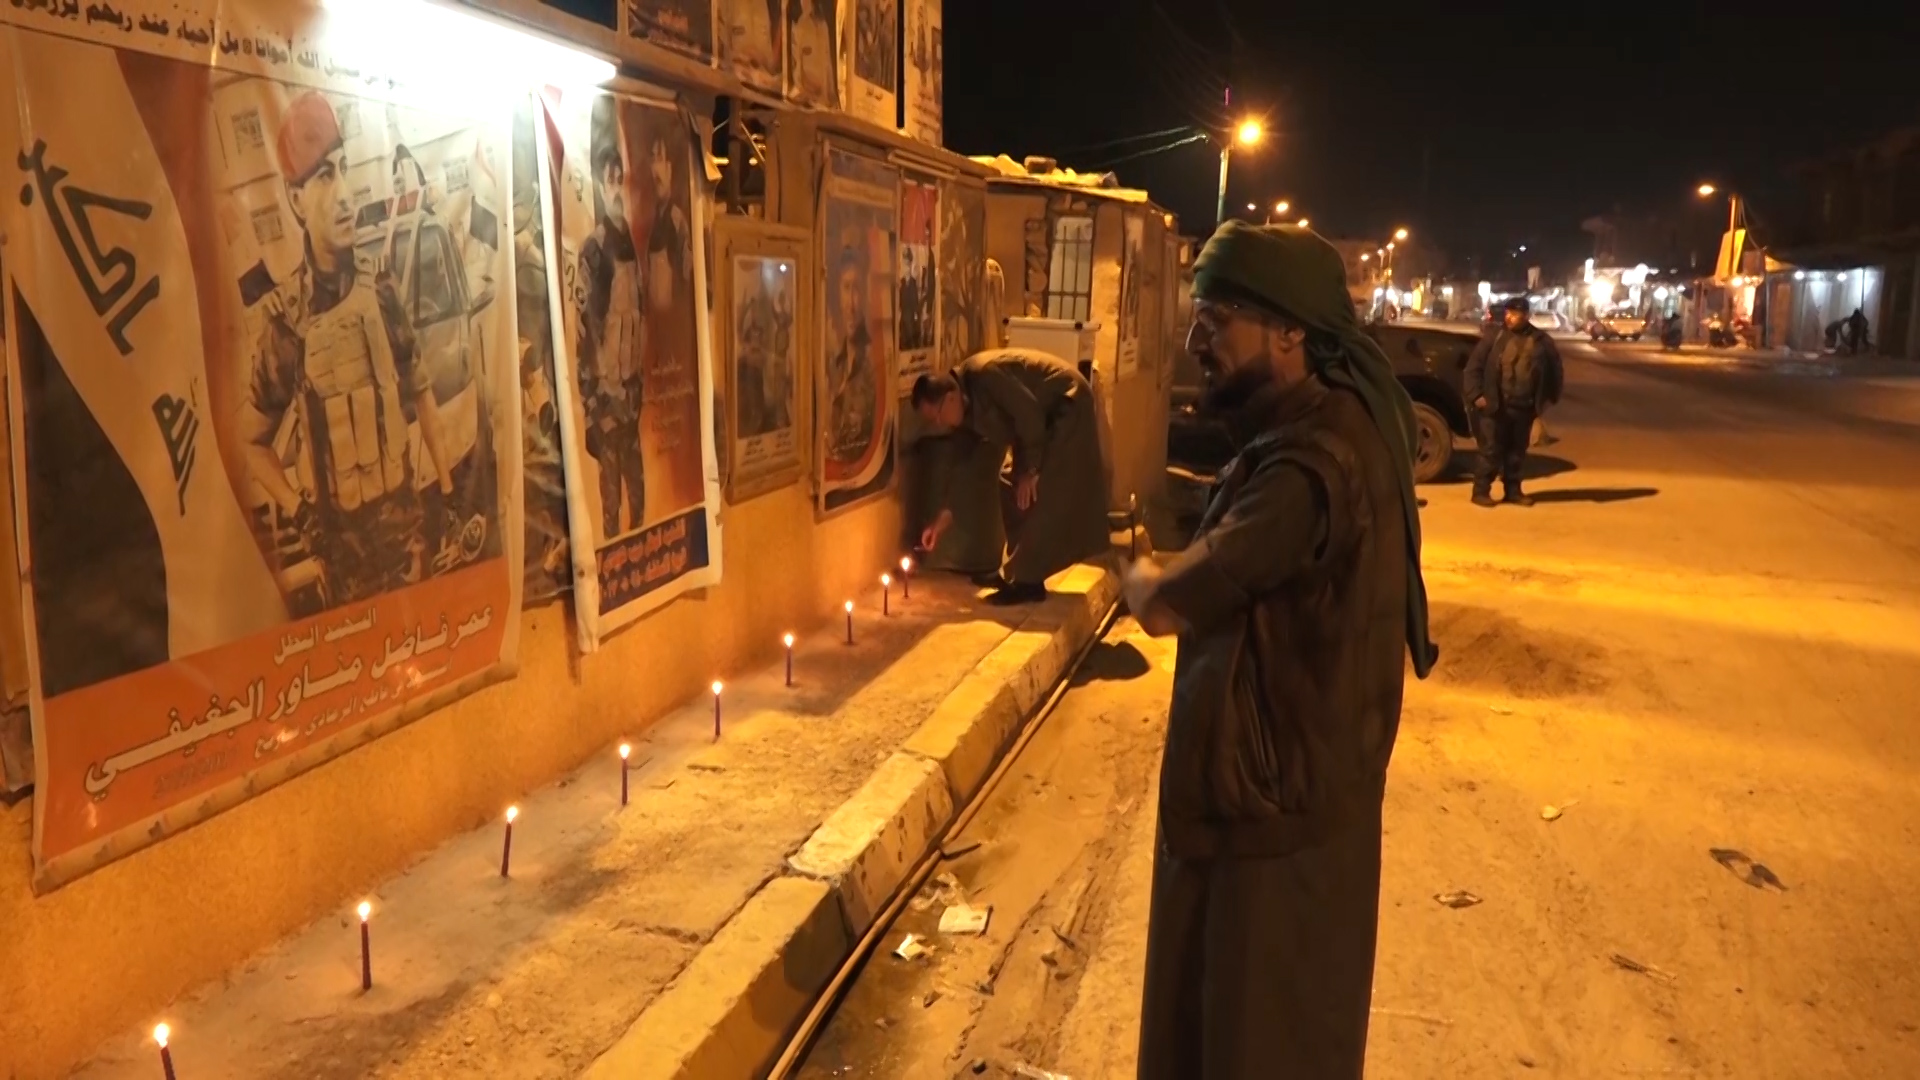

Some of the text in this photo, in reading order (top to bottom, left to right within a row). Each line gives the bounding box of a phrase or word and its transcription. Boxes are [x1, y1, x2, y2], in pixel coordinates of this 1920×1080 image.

[86, 3, 133, 33] ربهم
[138, 13, 170, 36] عند
[176, 18, 216, 46] أحياء
[220, 30, 239, 56] بل
[297, 49, 319, 69] الله
[450, 605, 493, 650] عمر
[371, 613, 449, 680] فاضل
[268, 653, 363, 722] مناور
[84, 676, 265, 802] الجغيفي
